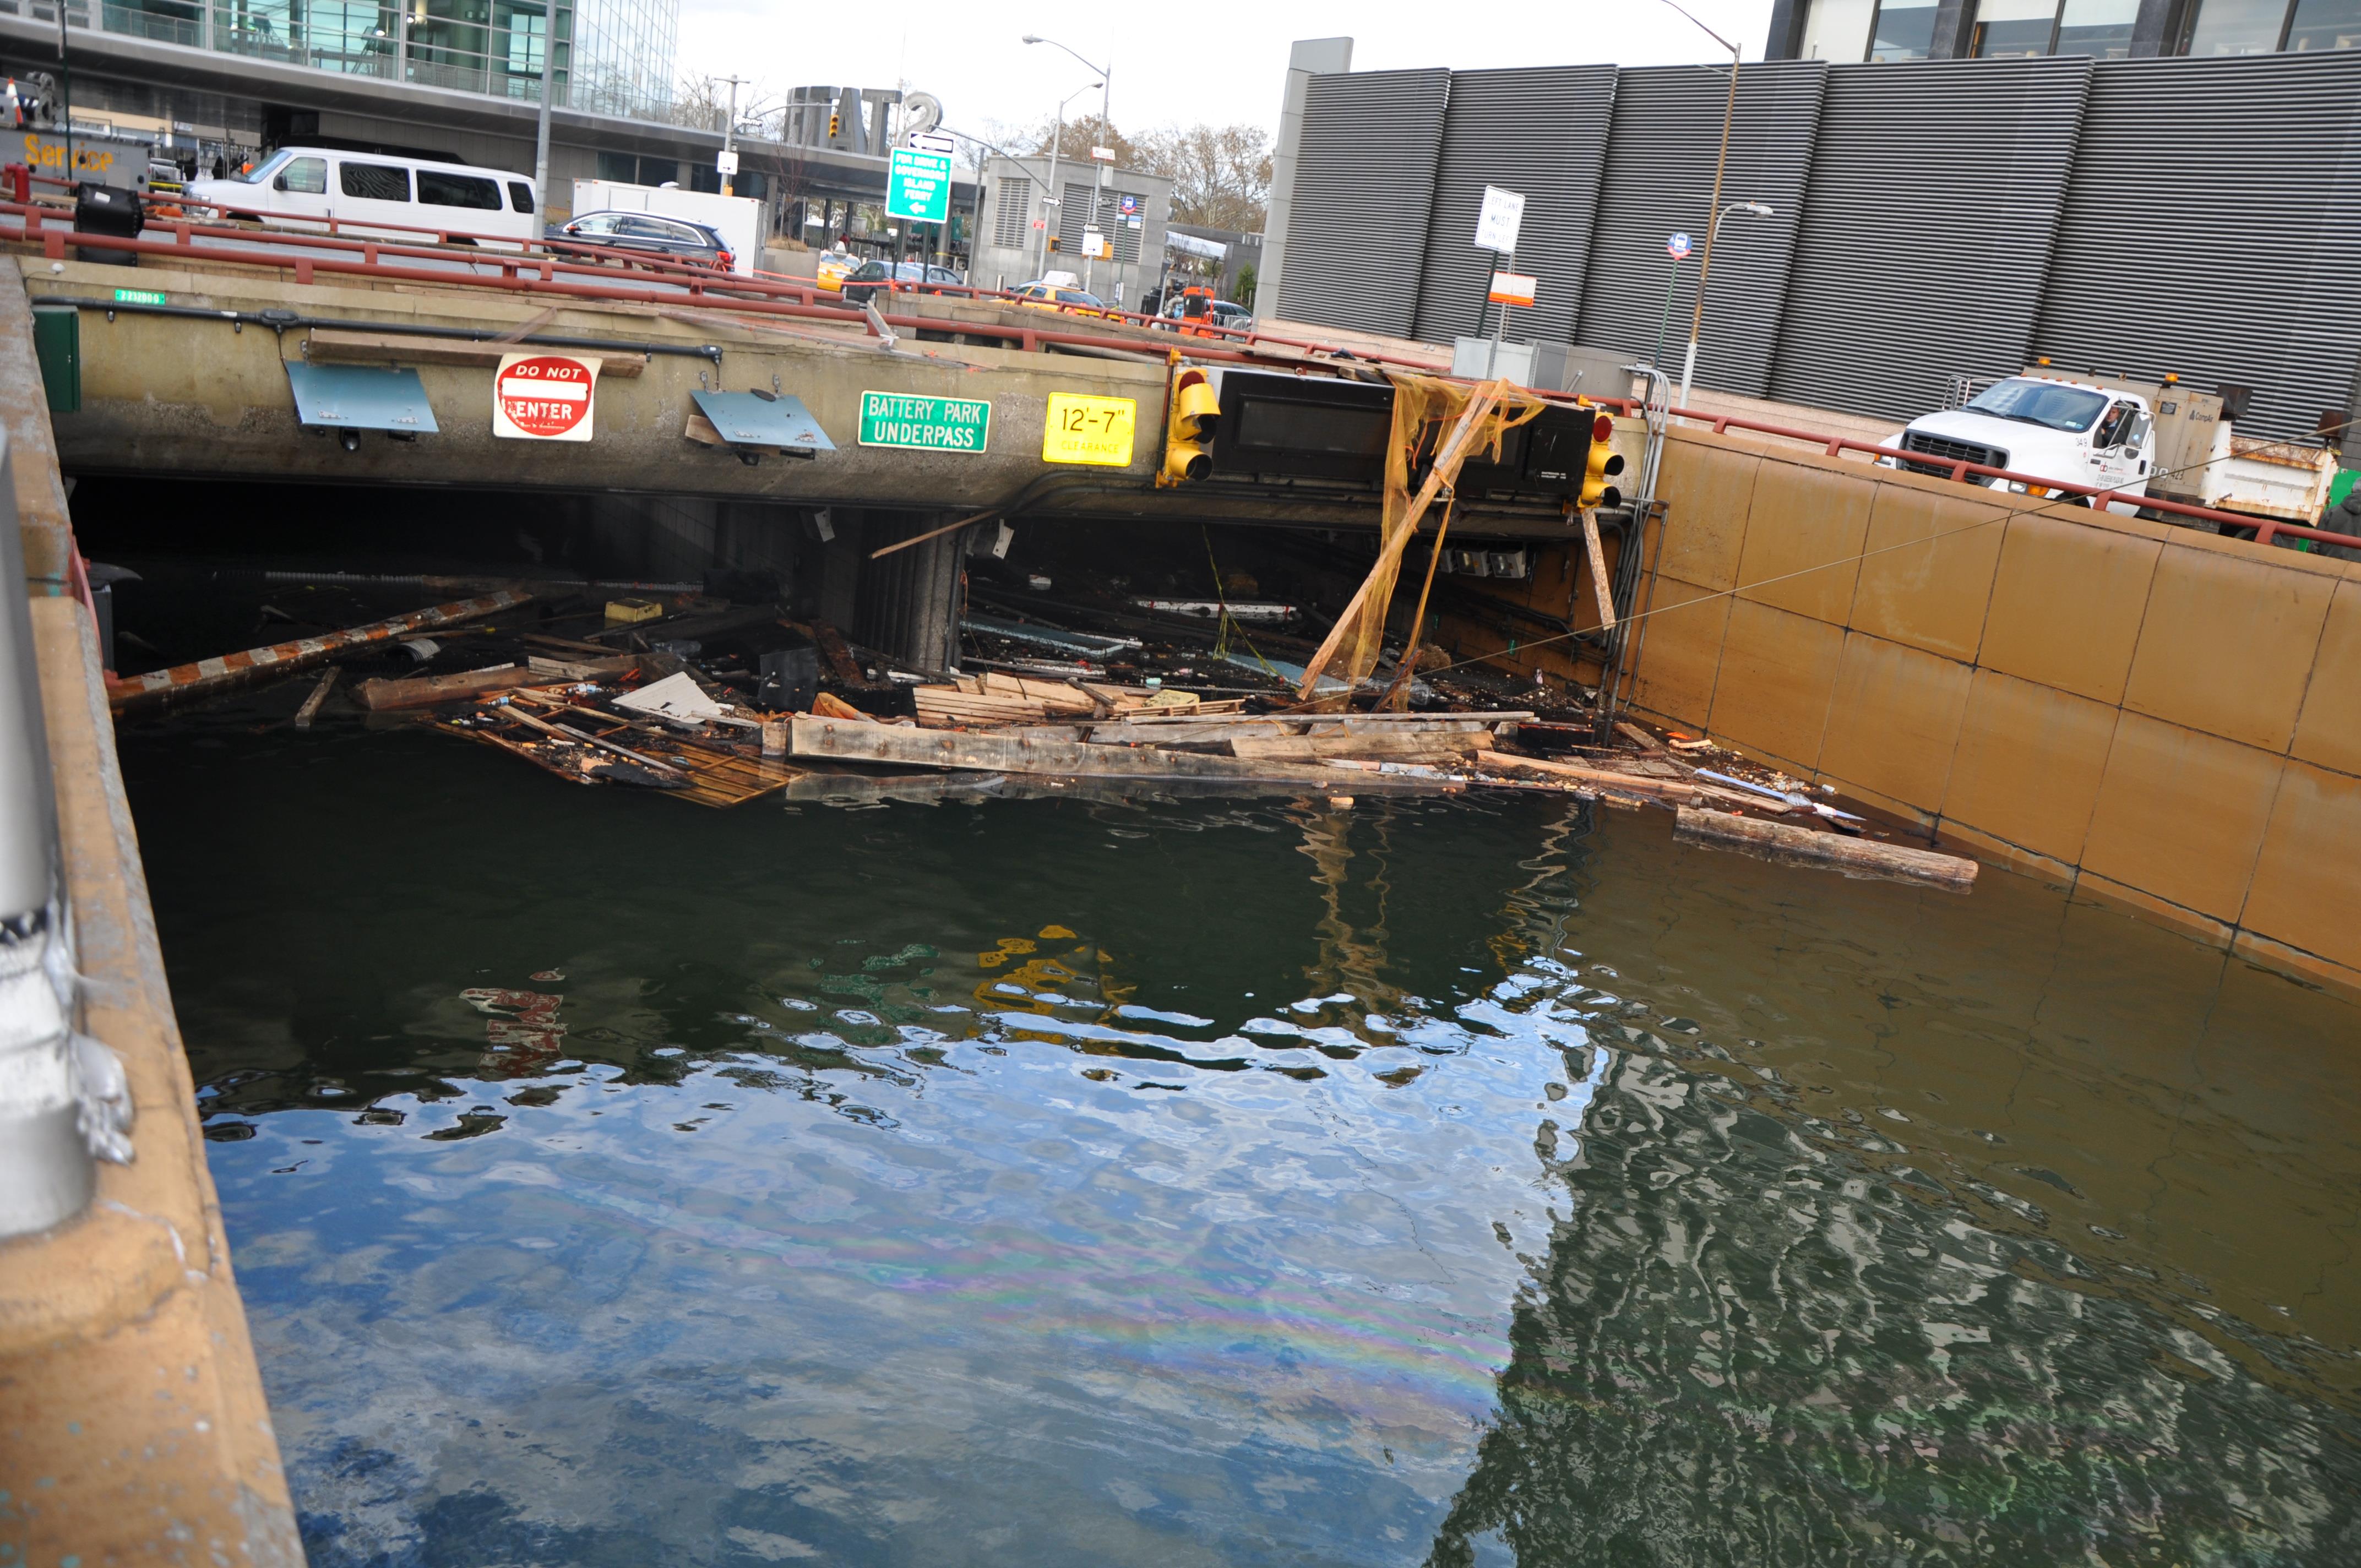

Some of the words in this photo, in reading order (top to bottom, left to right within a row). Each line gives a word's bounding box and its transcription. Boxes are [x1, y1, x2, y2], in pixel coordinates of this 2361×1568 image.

[24, 134, 114, 172] Service
[895, 165, 946, 182] GOVERNORS
[904, 177, 936, 191] ISLAND
[905, 189, 933, 202] FERRY
[1488, 196, 1502, 206] LEFT
[1504, 200, 1520, 212] LANE
[1490, 213, 1510, 227] MUST
[1481, 228, 1497, 240] TURN
[515, 365, 540, 377] DO
[546, 367, 582, 379] NOT
[516, 401, 572, 420] ENTER
[868, 396, 935, 420] BATTERY
[944, 402, 982, 424] PARK
[874, 421, 974, 448] UNDERPASS
[1061, 440, 1119, 454] CLEARANCE
